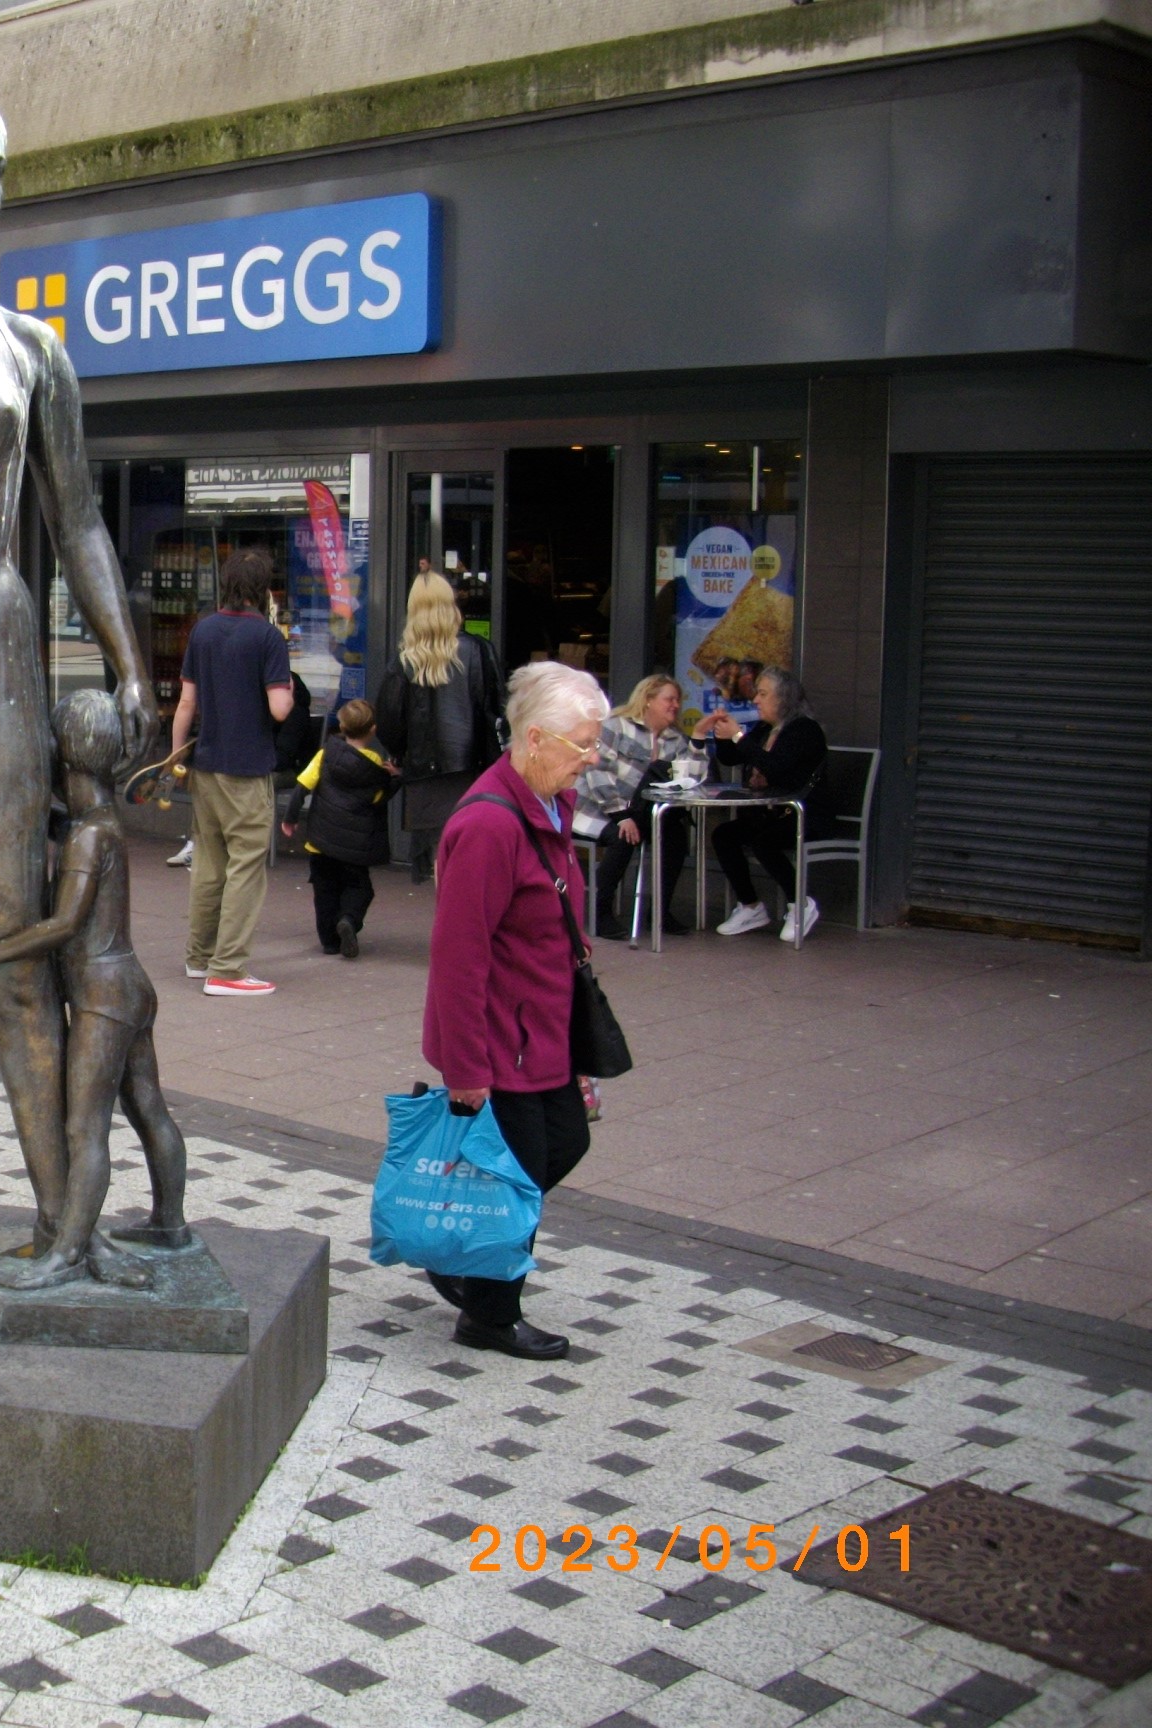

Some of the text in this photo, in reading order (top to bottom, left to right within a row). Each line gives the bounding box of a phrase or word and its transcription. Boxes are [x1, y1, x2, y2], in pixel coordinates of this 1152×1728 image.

[84, 230, 402, 345] GREGGS
[705, 543, 733, 554] VEGAN
[690, 555, 748, 570] MEXICAN
[703, 579, 734, 593] BAKE
[395, 1195, 511, 1217] www.savers.co.uk
